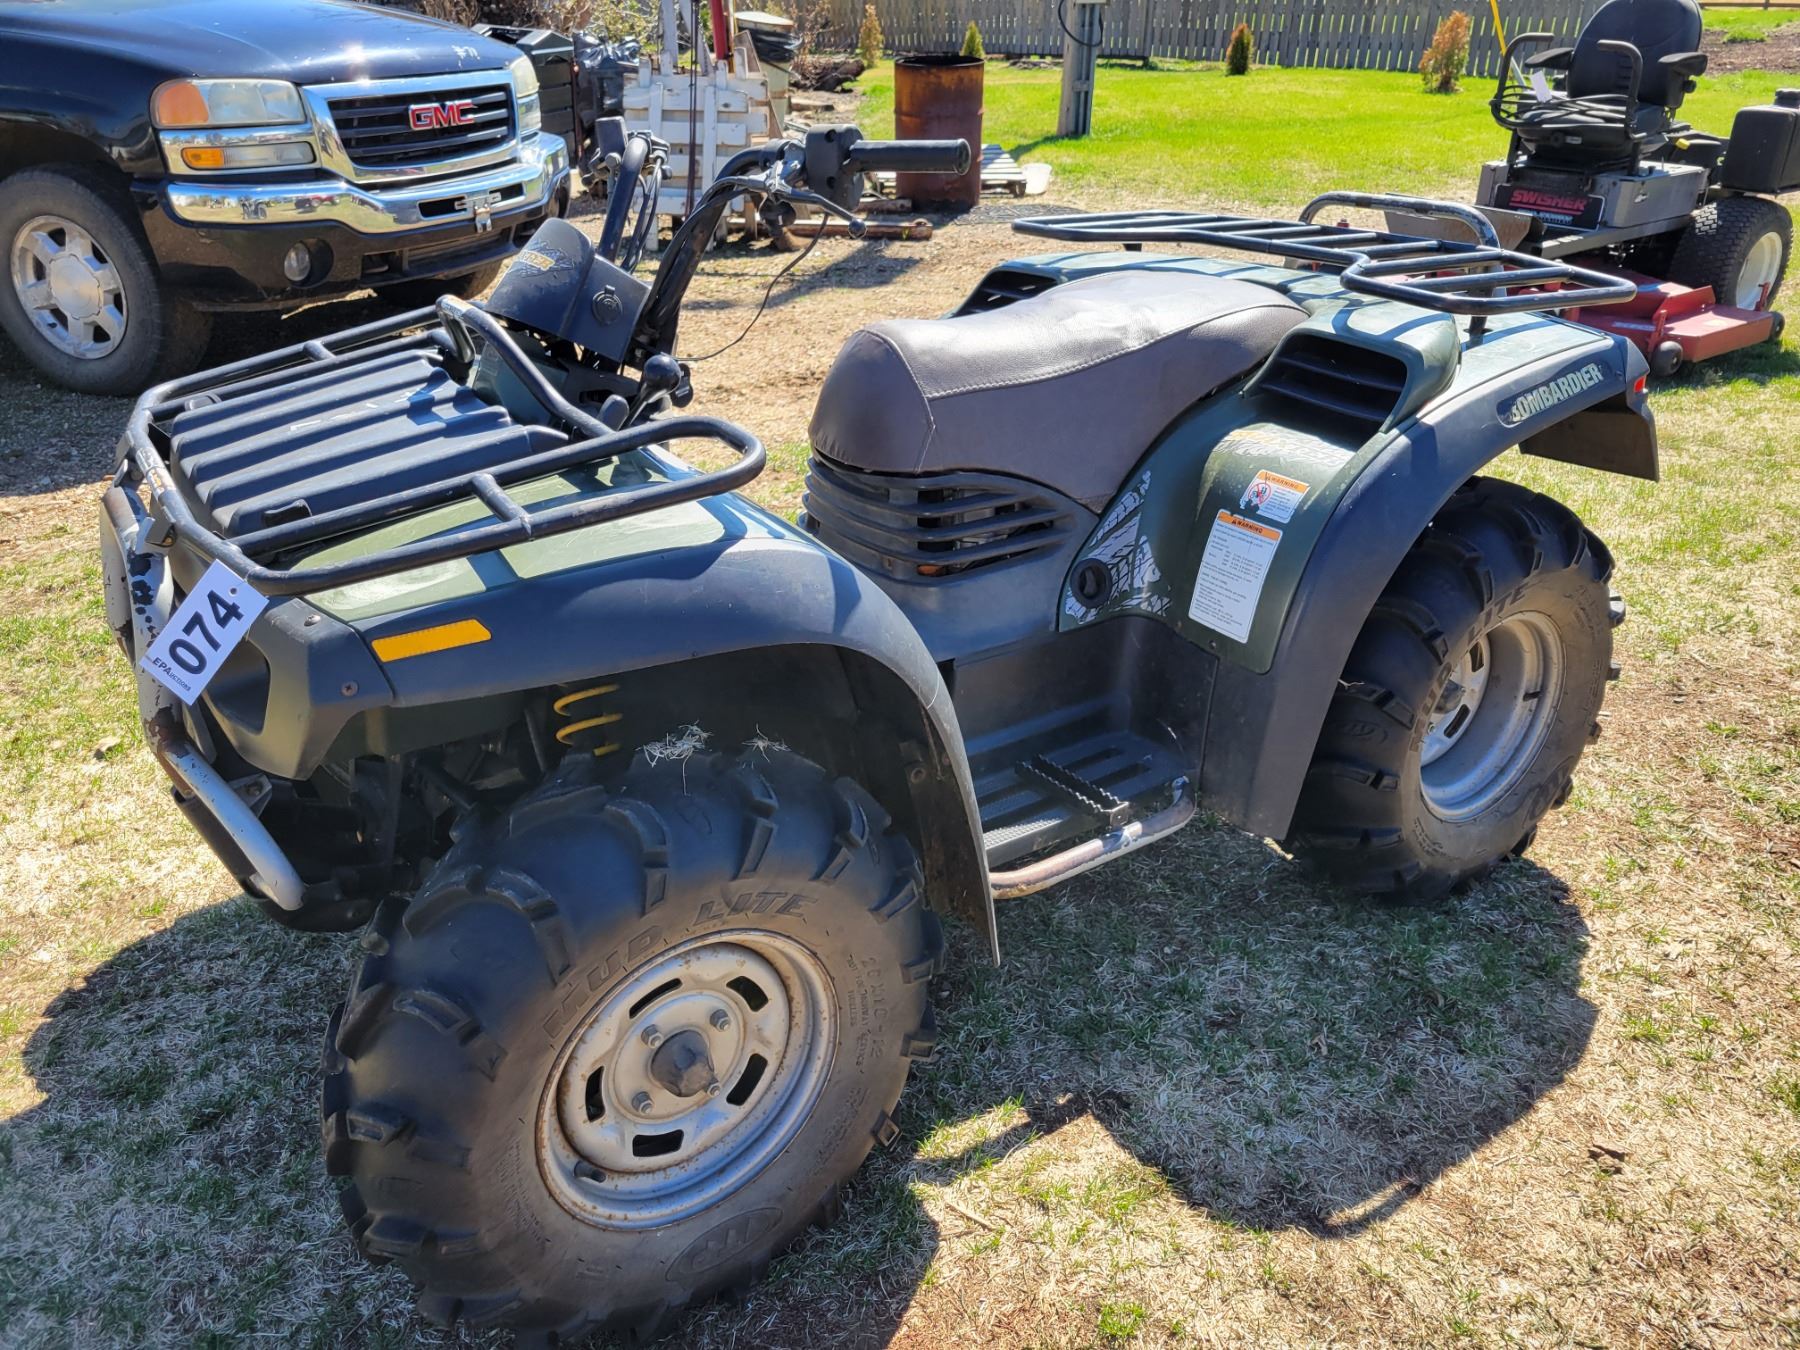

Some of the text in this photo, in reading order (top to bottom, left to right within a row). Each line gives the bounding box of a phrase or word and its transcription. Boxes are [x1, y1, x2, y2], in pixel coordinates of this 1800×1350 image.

[409, 99, 477, 131] GMC
[1510, 189, 1588, 211] SWISHER
[1511, 362, 1604, 423] BOMBARDIER
[1270, 476, 1299, 490] WARNING
[1236, 519, 1263, 534] WARNING
[169, 589, 245, 675] 074
[542, 891, 818, 1040] MUD LITE
